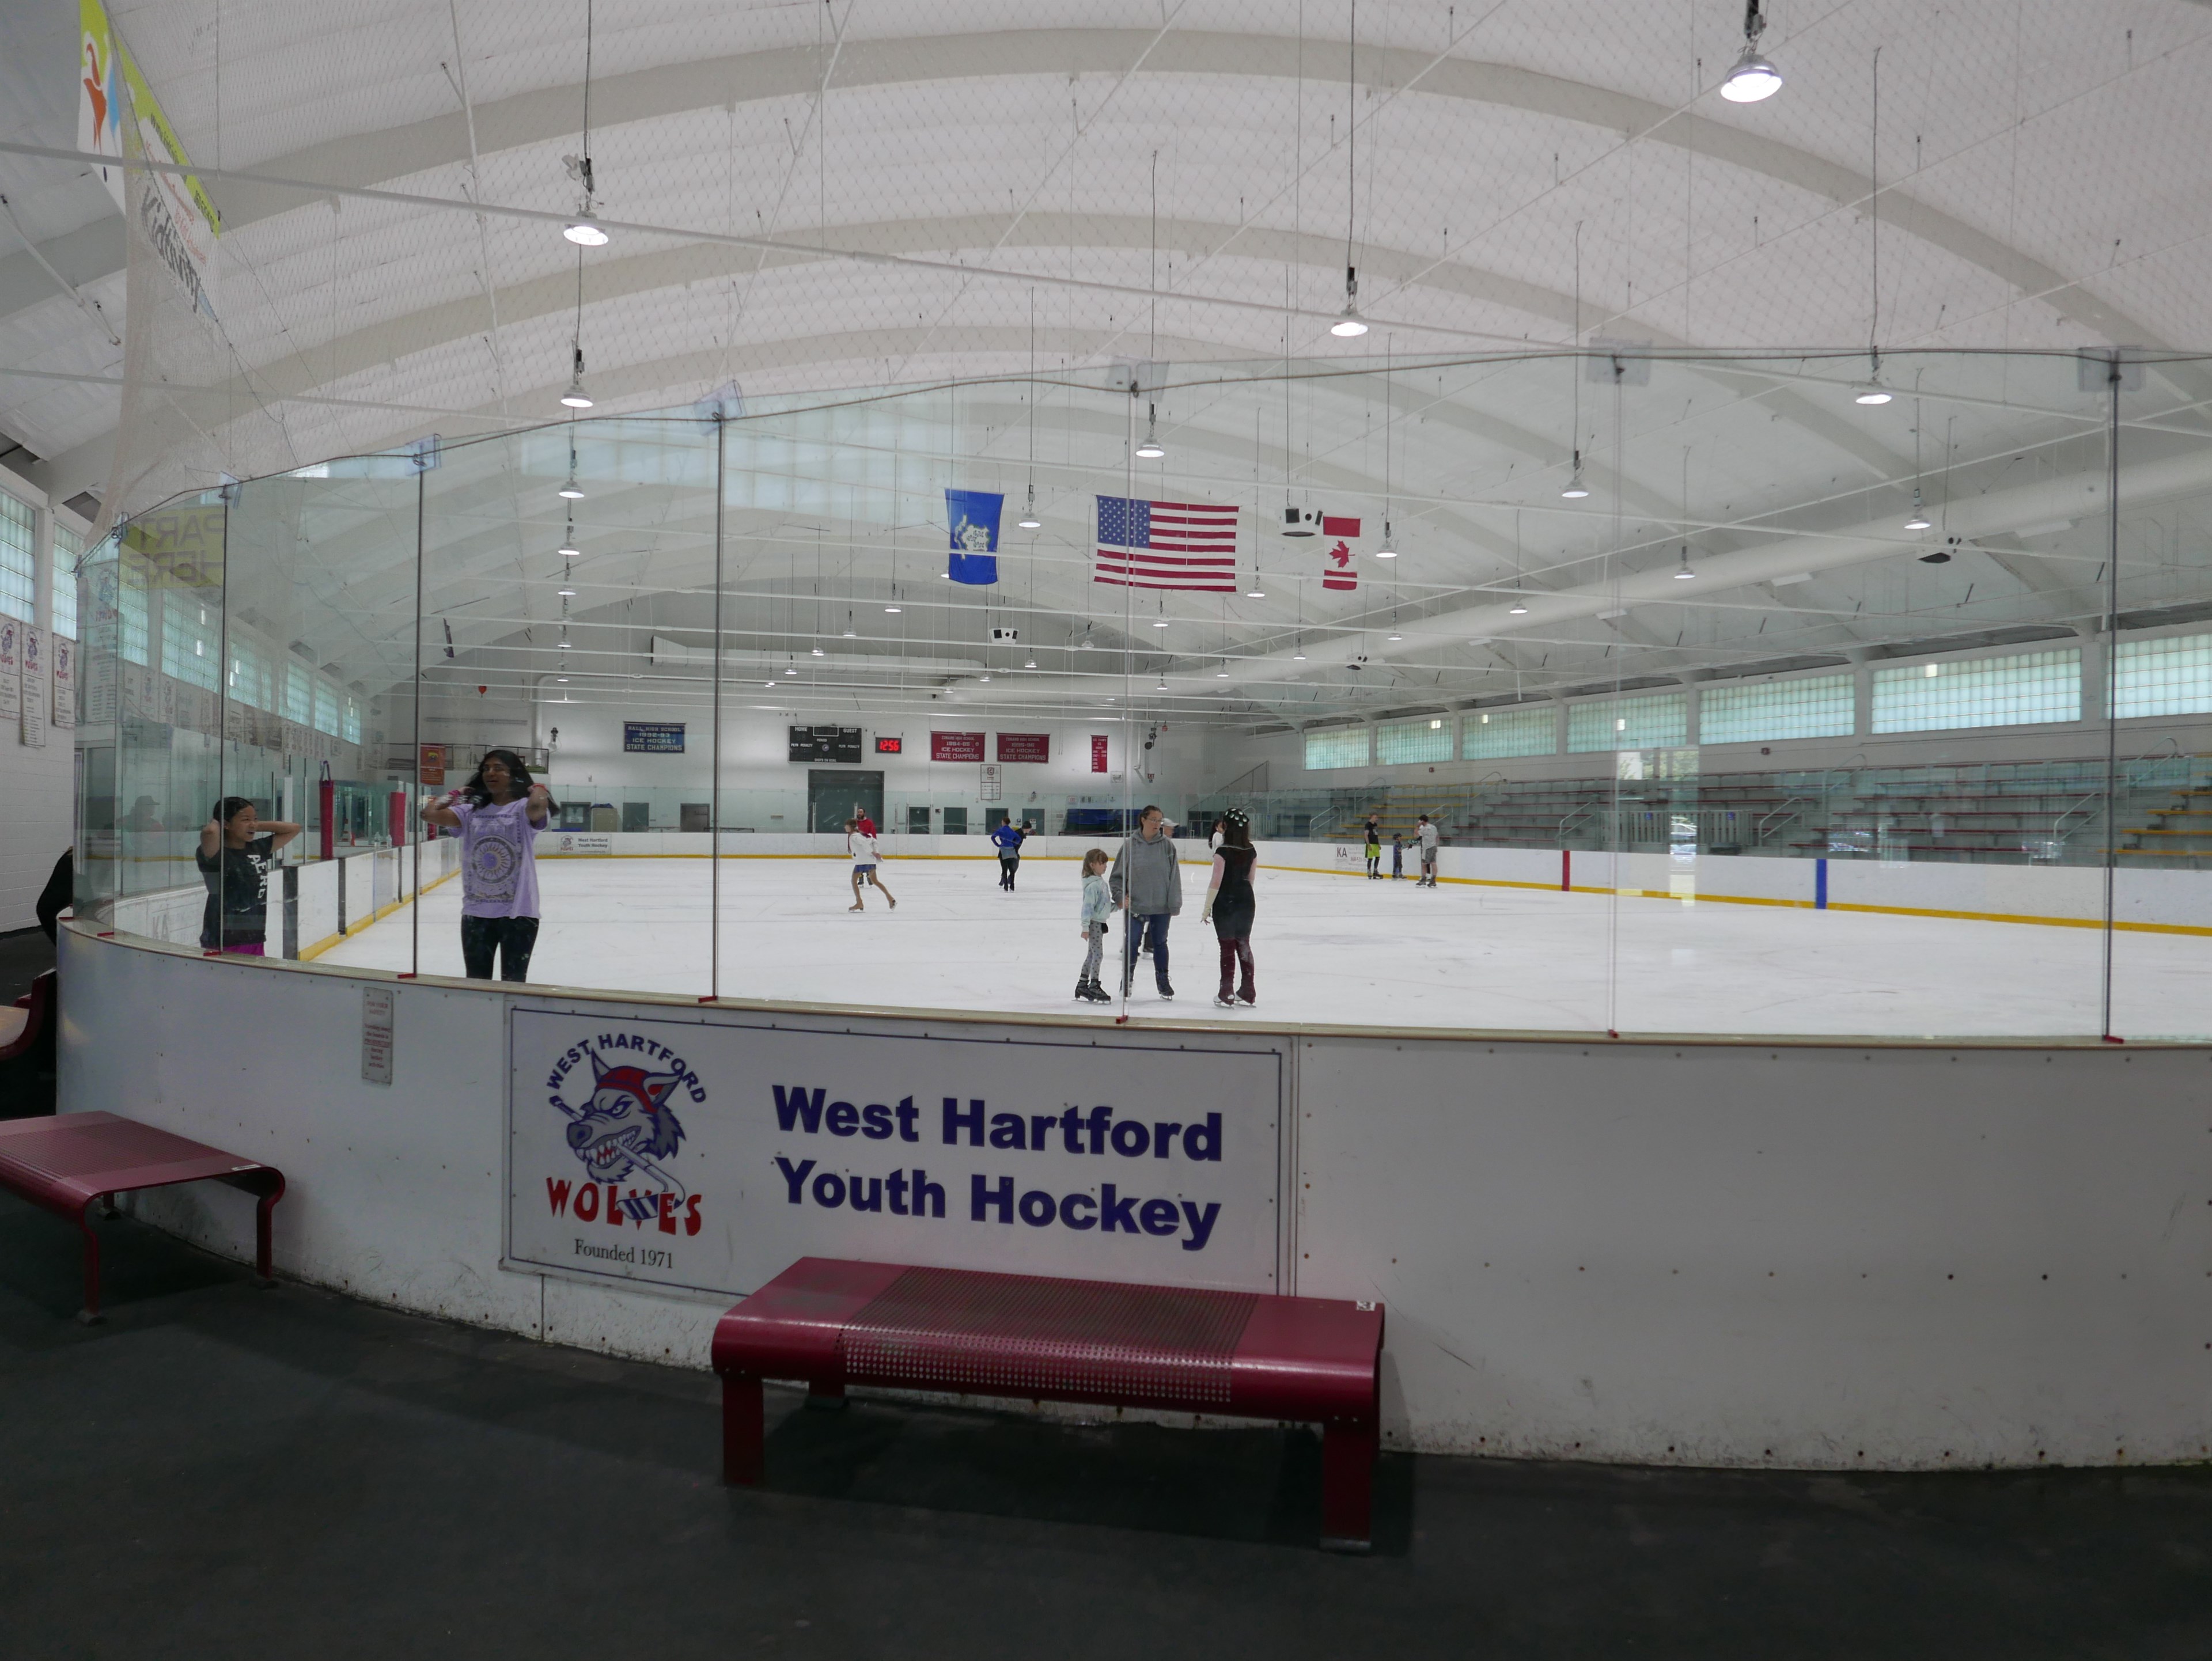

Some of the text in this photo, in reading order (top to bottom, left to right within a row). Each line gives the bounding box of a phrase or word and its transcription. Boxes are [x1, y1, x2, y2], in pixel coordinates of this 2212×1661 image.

[1337, 847, 1347, 858] KA
[547, 1033, 706, 1103] WEST HARTFORD
[772, 1085, 1222, 1162] West Hartford
[774, 1156, 1222, 1251] Youth Hockey
[575, 1239, 673, 1269] Founded 1971
